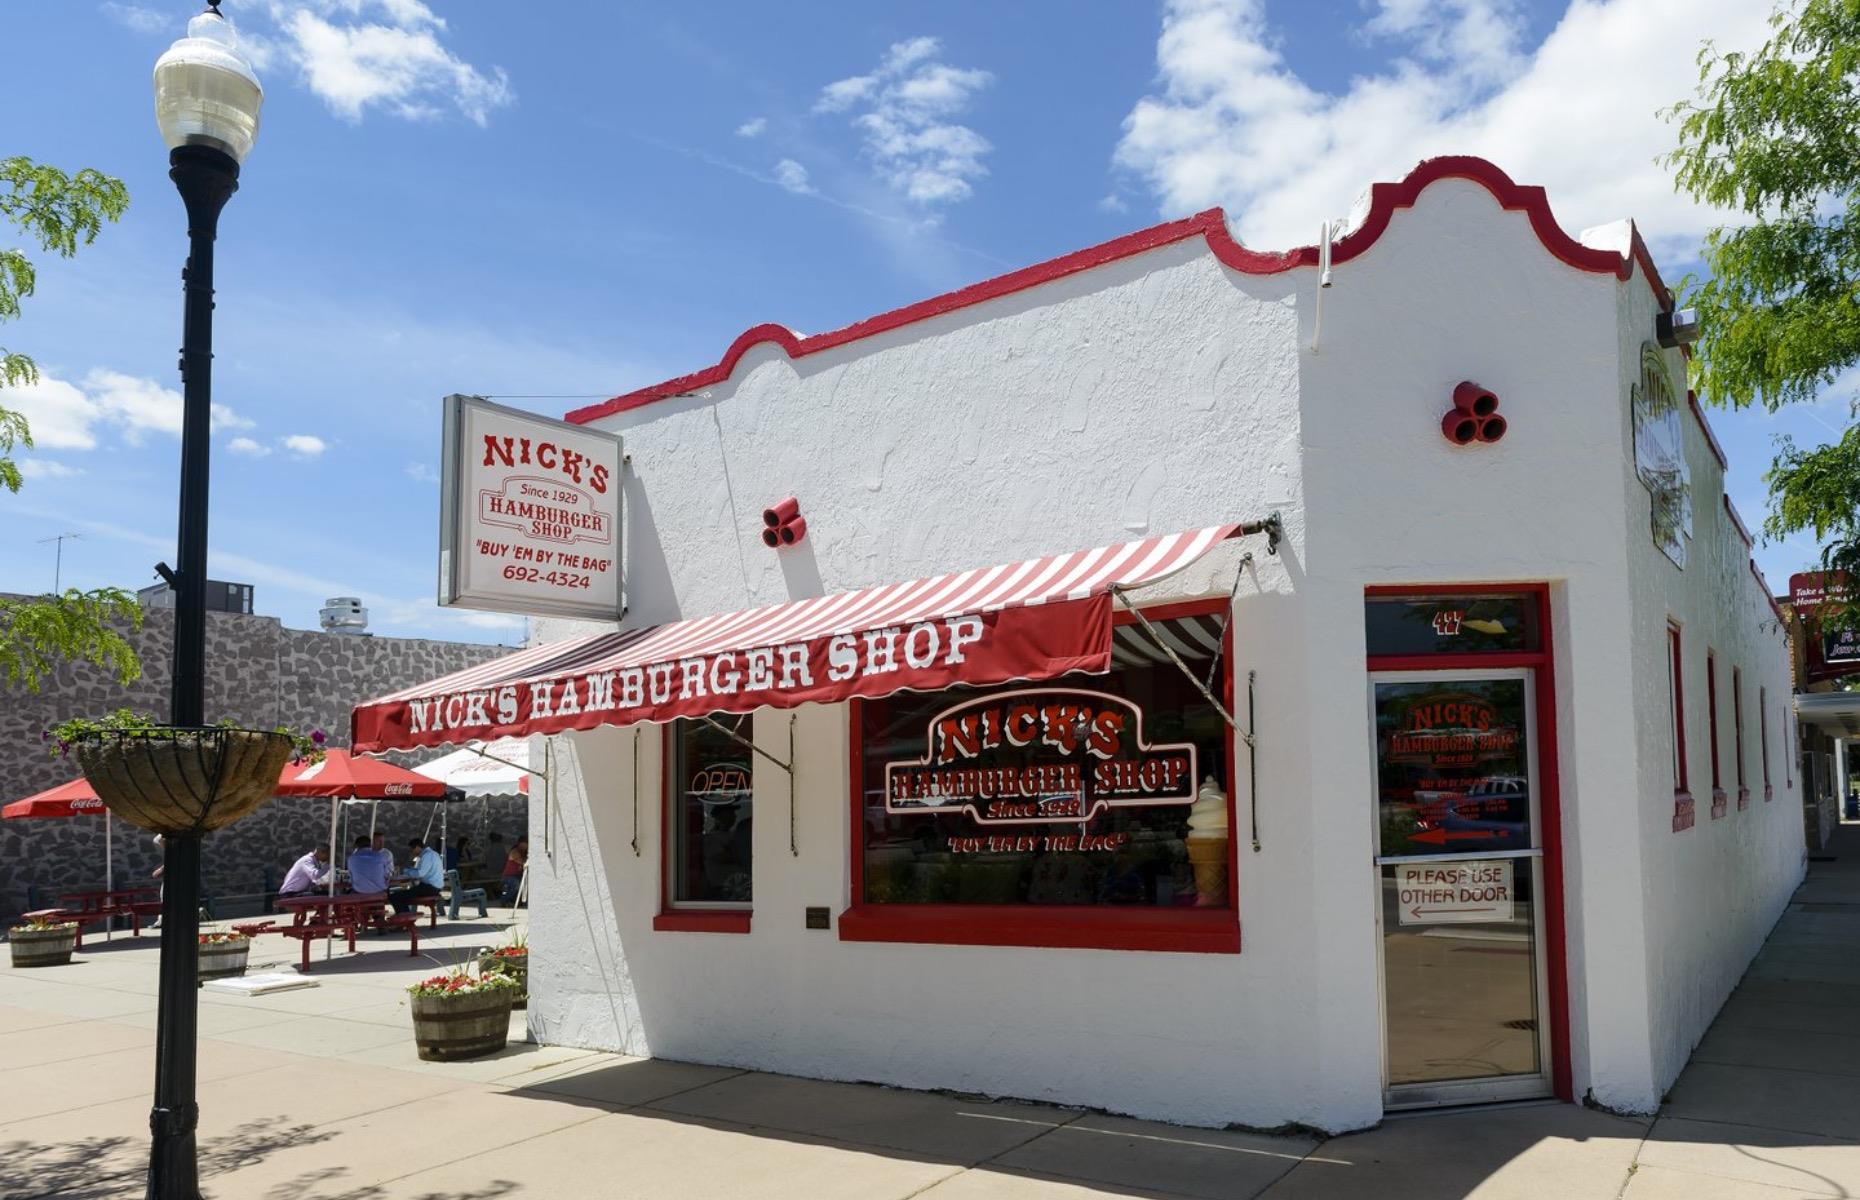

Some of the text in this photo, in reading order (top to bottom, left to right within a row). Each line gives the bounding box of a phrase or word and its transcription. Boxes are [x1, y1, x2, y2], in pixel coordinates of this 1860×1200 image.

[483, 434, 609, 494] NICK'S
[521, 484, 578, 504] Since 1929
[489, 496, 603, 532] HAMBURGER
[532, 521, 572, 539] SHOP
[477, 539, 612, 572] "BUY 'EM BY THE BAG"
[503, 565, 590, 589] 692-4324
[1432, 609, 1466, 635] 427
[410, 614, 984, 733] NICK'S HAMBURGER SHOP
[1414, 703, 1490, 732] NICK'S
[937, 705, 1125, 765] NICK'S
[692, 770, 753, 797] OPEN
[892, 757, 1188, 801] HAMBURGER SHOP
[987, 801, 1038, 818] Since
[1045, 835, 1079, 852] THE
[1407, 868, 1502, 885] PLEASE USE
[1400, 887, 1508, 904] OTHER DOOR
